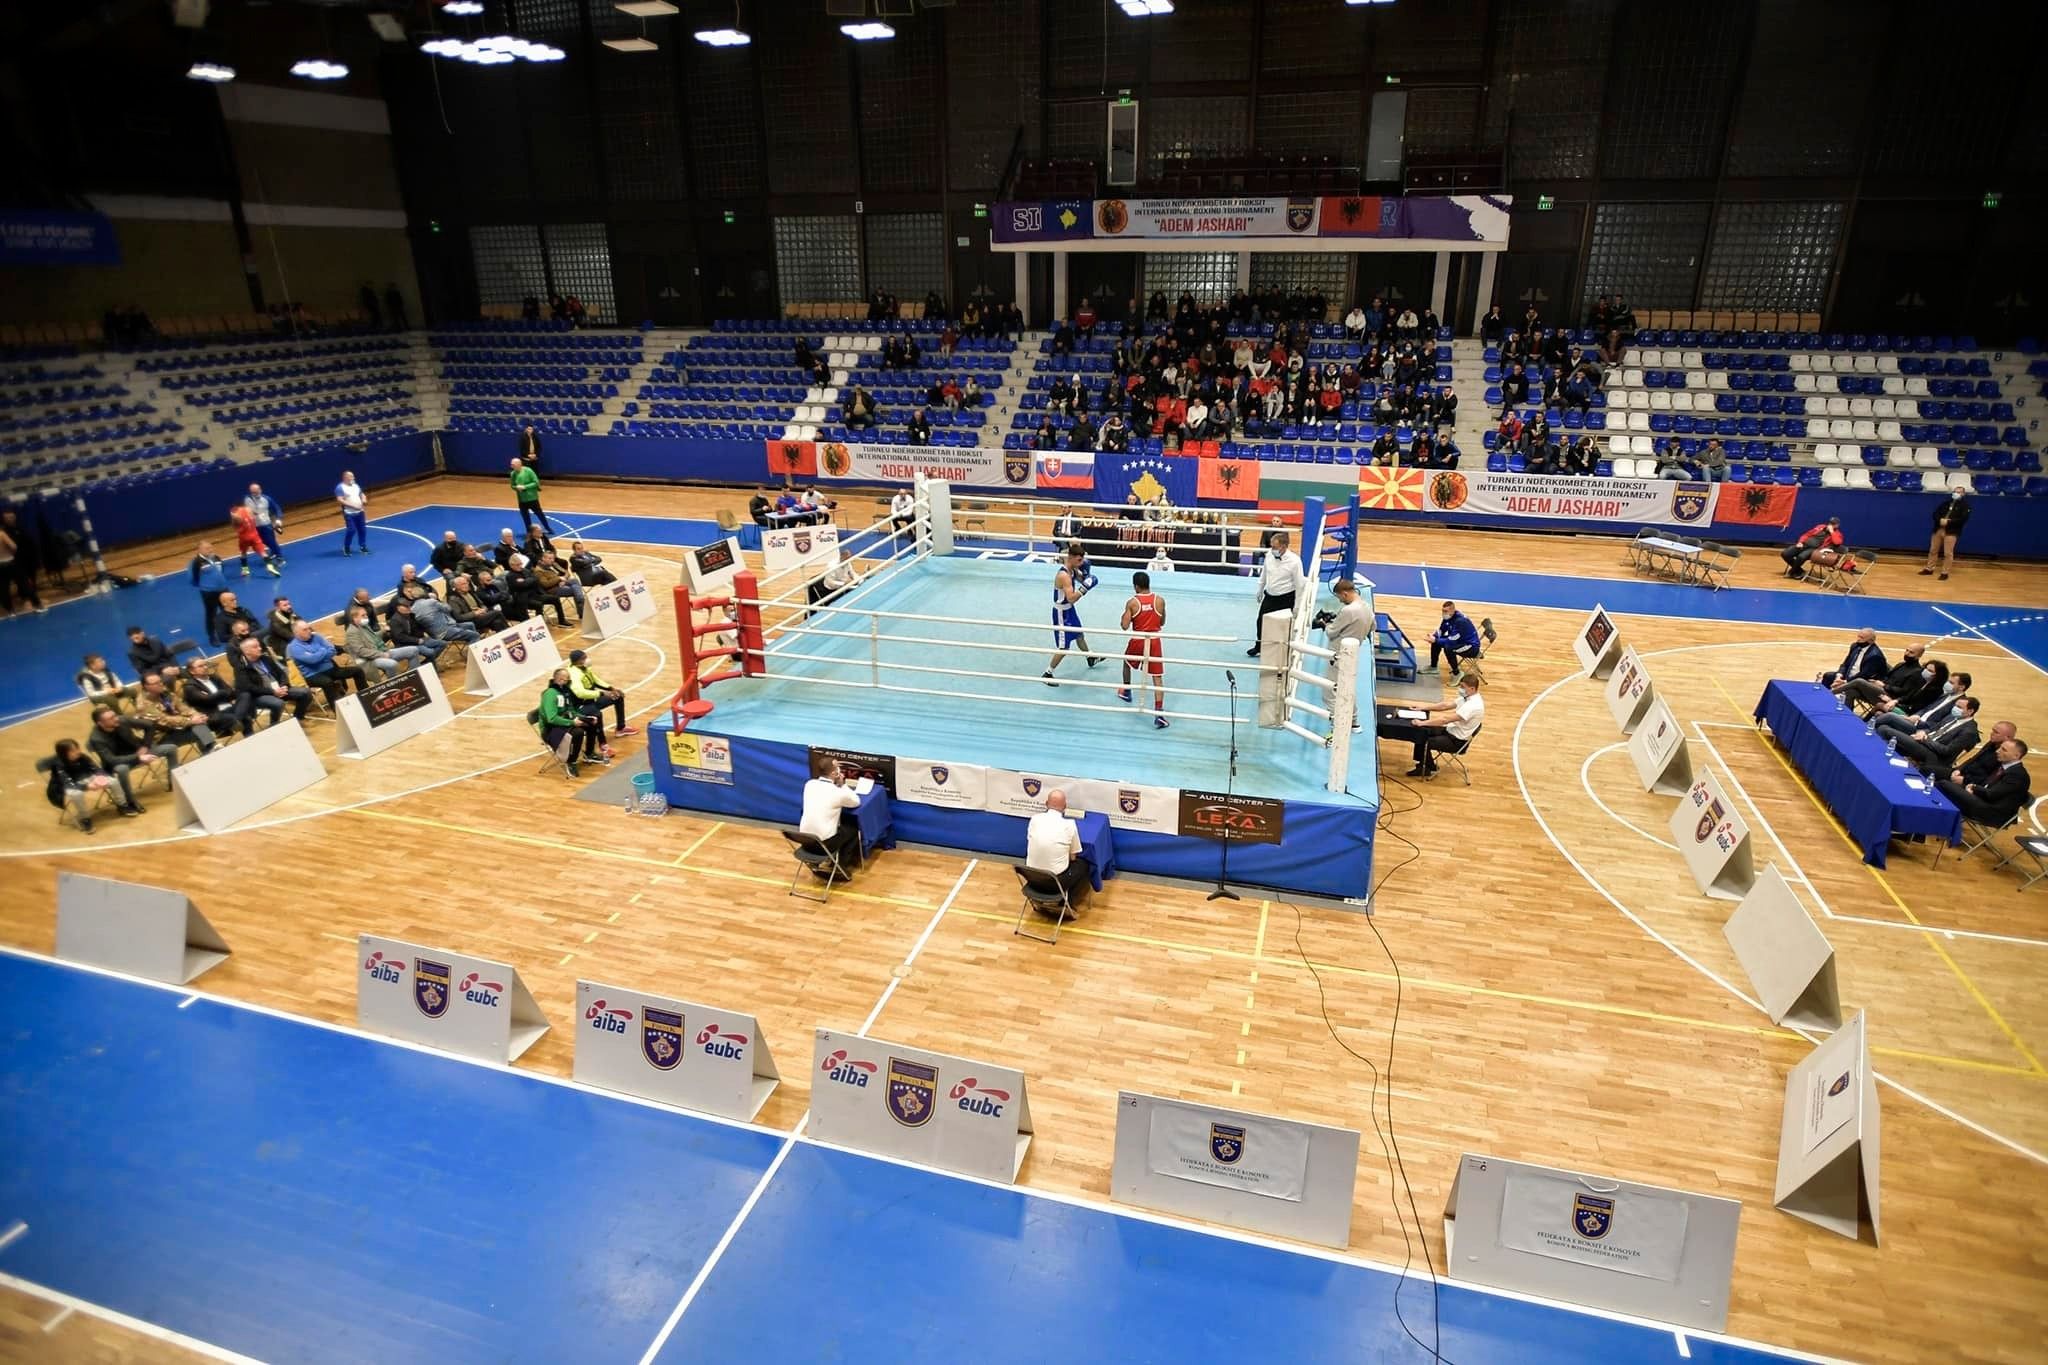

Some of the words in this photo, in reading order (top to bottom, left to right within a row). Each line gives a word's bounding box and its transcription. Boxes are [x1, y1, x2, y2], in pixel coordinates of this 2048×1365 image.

[1013, 208, 1042, 232] SI
[2016, 397, 2025, 408] 6
[863, 446, 890, 454] TURNEU
[856, 453, 911, 462] INTERNATIONAL
[942, 457, 992, 465] TOURNAMENT
[1487, 476, 1523, 485] TURNEU
[1613, 481, 1648, 490] BOKSIT
[1477, 484, 1550, 495] INTERNATIONAL
[1553, 486, 1589, 497] BOXING
[1592, 488, 1658, 500] TOURNAMENT
[531, 631, 547, 643] eubc
[487, 649, 502, 664] aiba
[375, 691, 414, 712] LEKA
[706, 750, 725, 760] aiba
[847, 753, 879, 762] CENTER
[1199, 794, 1225, 802] AUTO
[1226, 797, 1263, 806] CENTER
[1196, 812, 1257, 829] LEKA
[371, 964, 399, 984] aiba
[466, 990, 499, 1007] eubc
[593, 1013, 626, 1034] aiba
[705, 1042, 743, 1060] eubc
[829, 1064, 869, 1088] aiba
[958, 1097, 1003, 1117] eubc
[1537, 1231, 1571, 1243] FEDERATA
[1577, 1239, 1601, 1249] BOKSIT
[1593, 1248, 1629, 1261] FEDERATION
